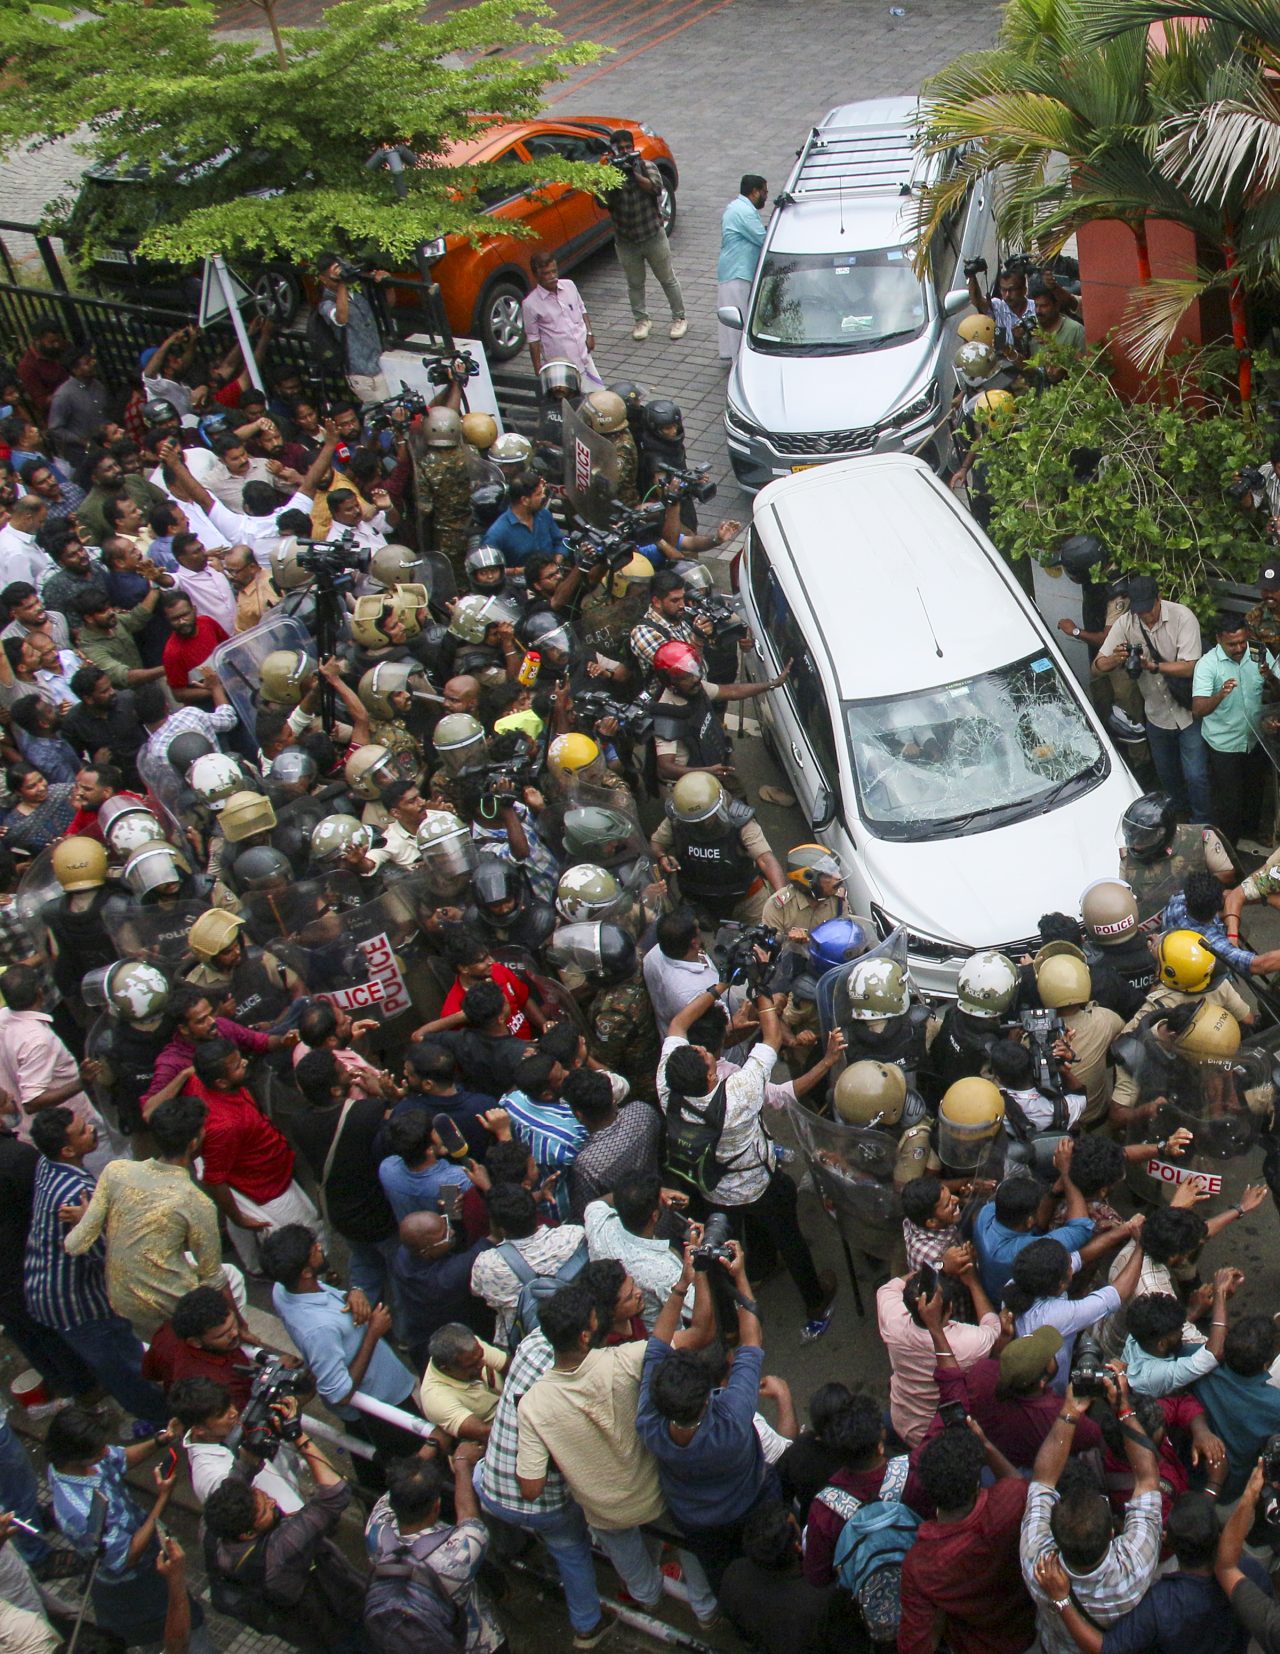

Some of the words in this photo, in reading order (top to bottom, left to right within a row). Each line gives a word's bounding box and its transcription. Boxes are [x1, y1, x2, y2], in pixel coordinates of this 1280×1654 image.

[576, 442, 590, 495] POLICE
[699, 711, 713, 740] POLICE
[688, 846, 721, 859] POLICE
[158, 926, 191, 941] POLIC
[1096, 917, 1133, 934] POLICE
[1129, 974, 1155, 989] OLICE
[235, 993, 263, 1018] OLICE
[317, 981, 385, 1010] OLICE
[1214, 1011, 1229, 1032] POLICE
